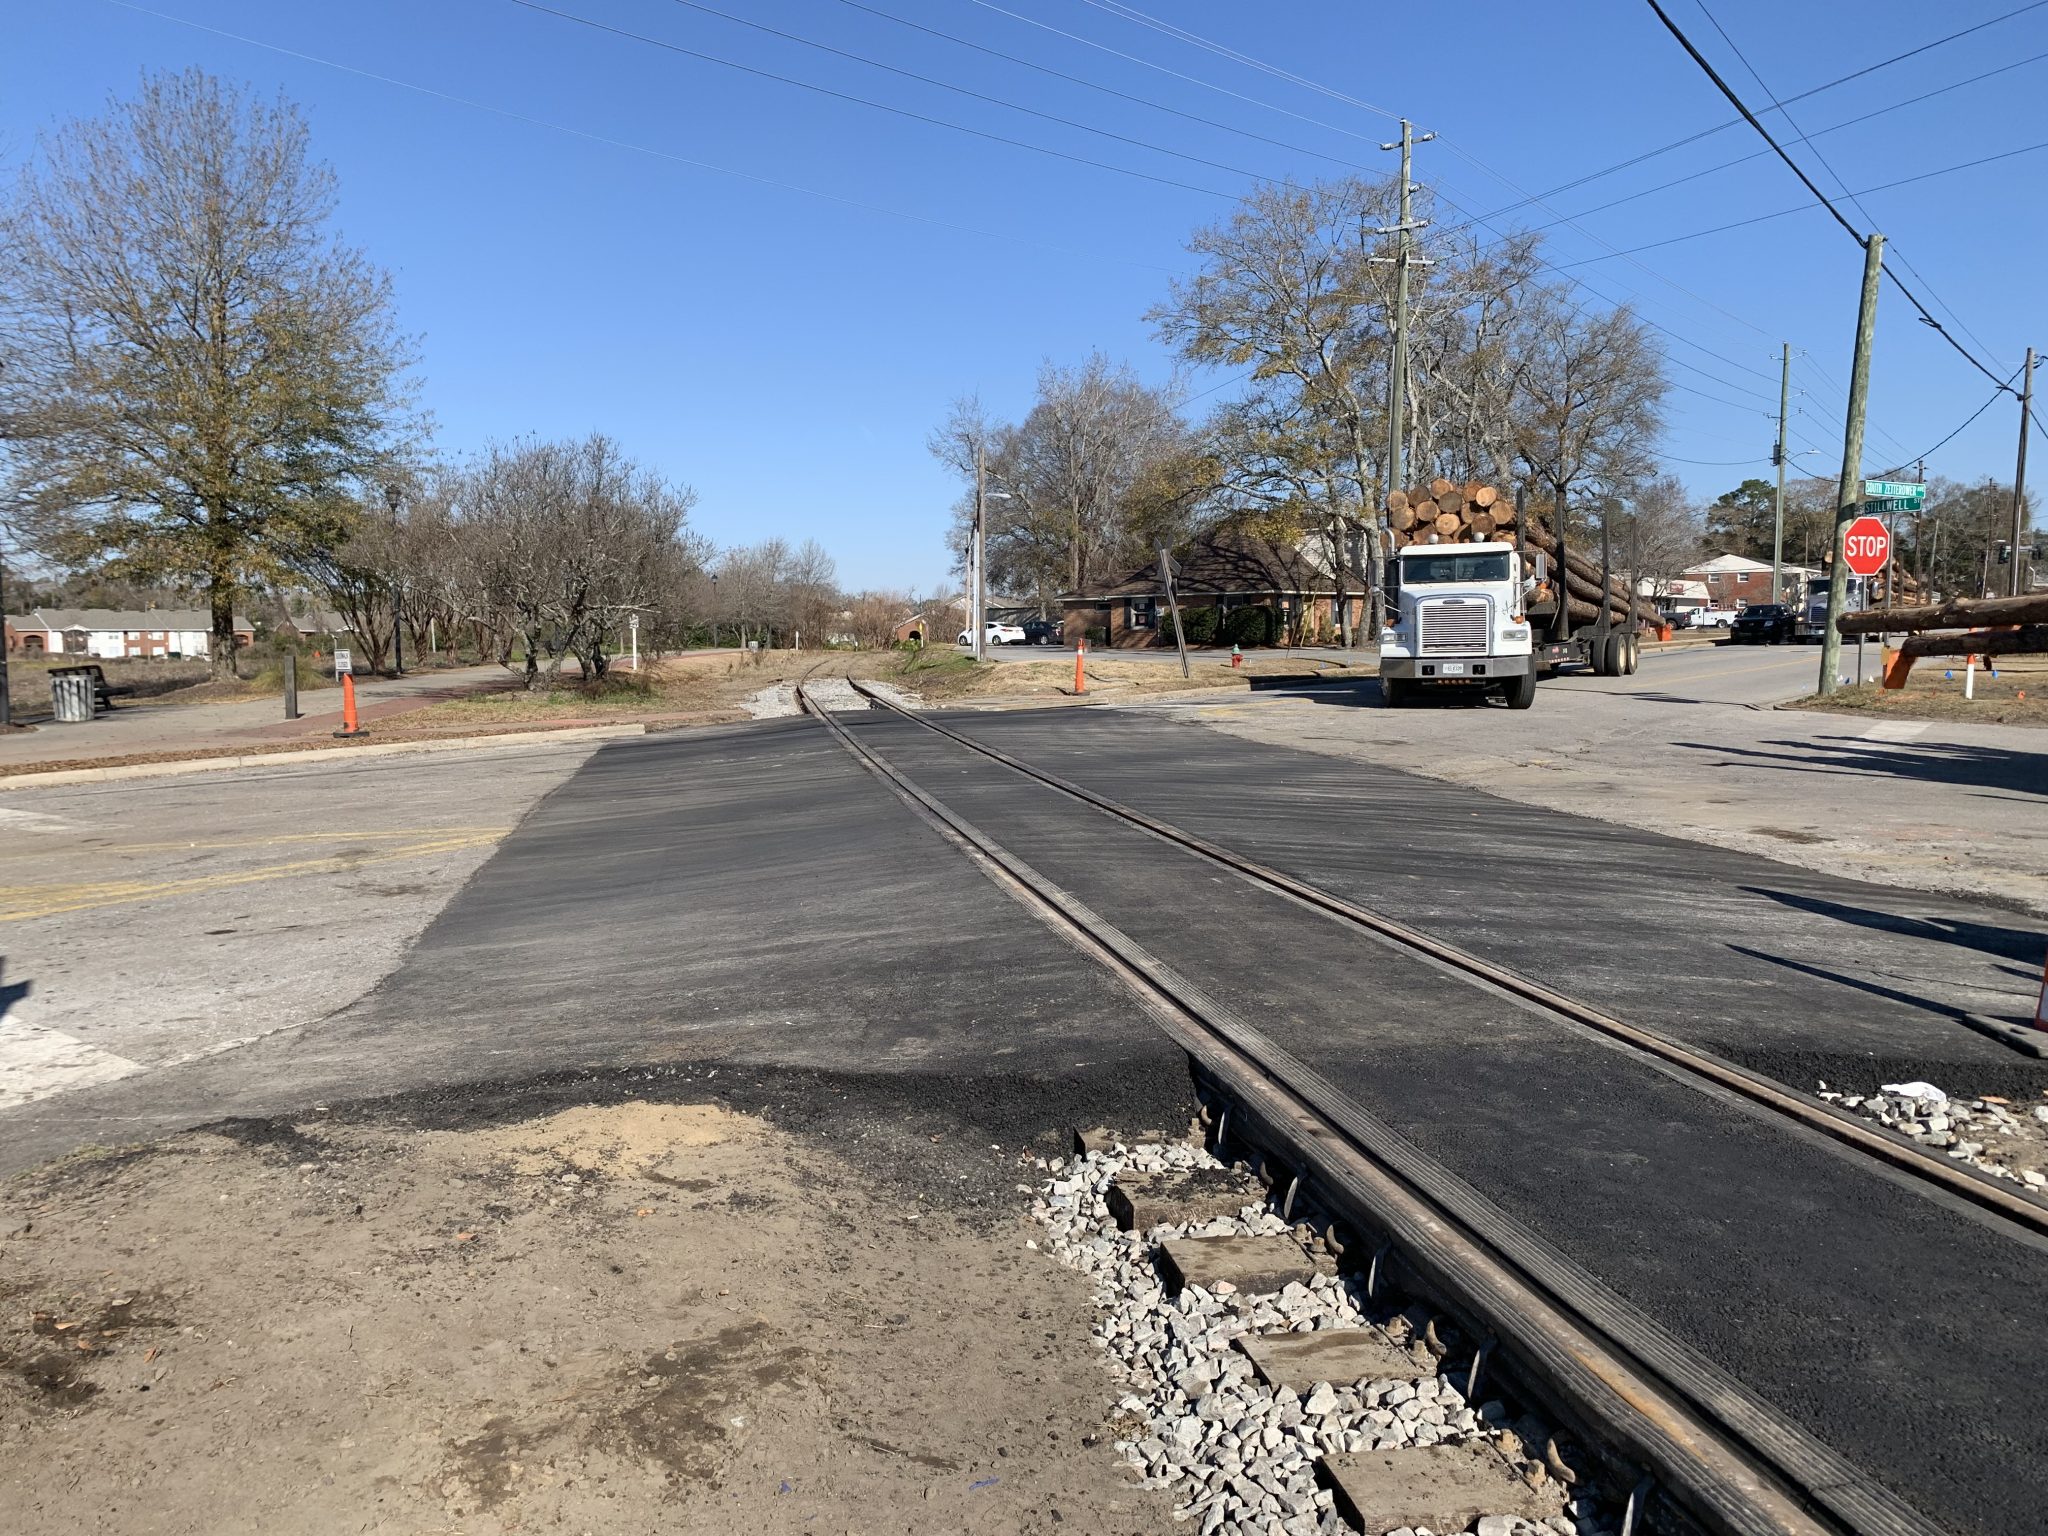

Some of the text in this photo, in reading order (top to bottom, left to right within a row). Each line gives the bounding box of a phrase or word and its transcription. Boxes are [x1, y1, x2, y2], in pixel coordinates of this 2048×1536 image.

[1866, 482, 1882, 495] SOUTH
[1865, 499, 1909, 515] STILLWELL
[1847, 535, 1887, 557] STOP
